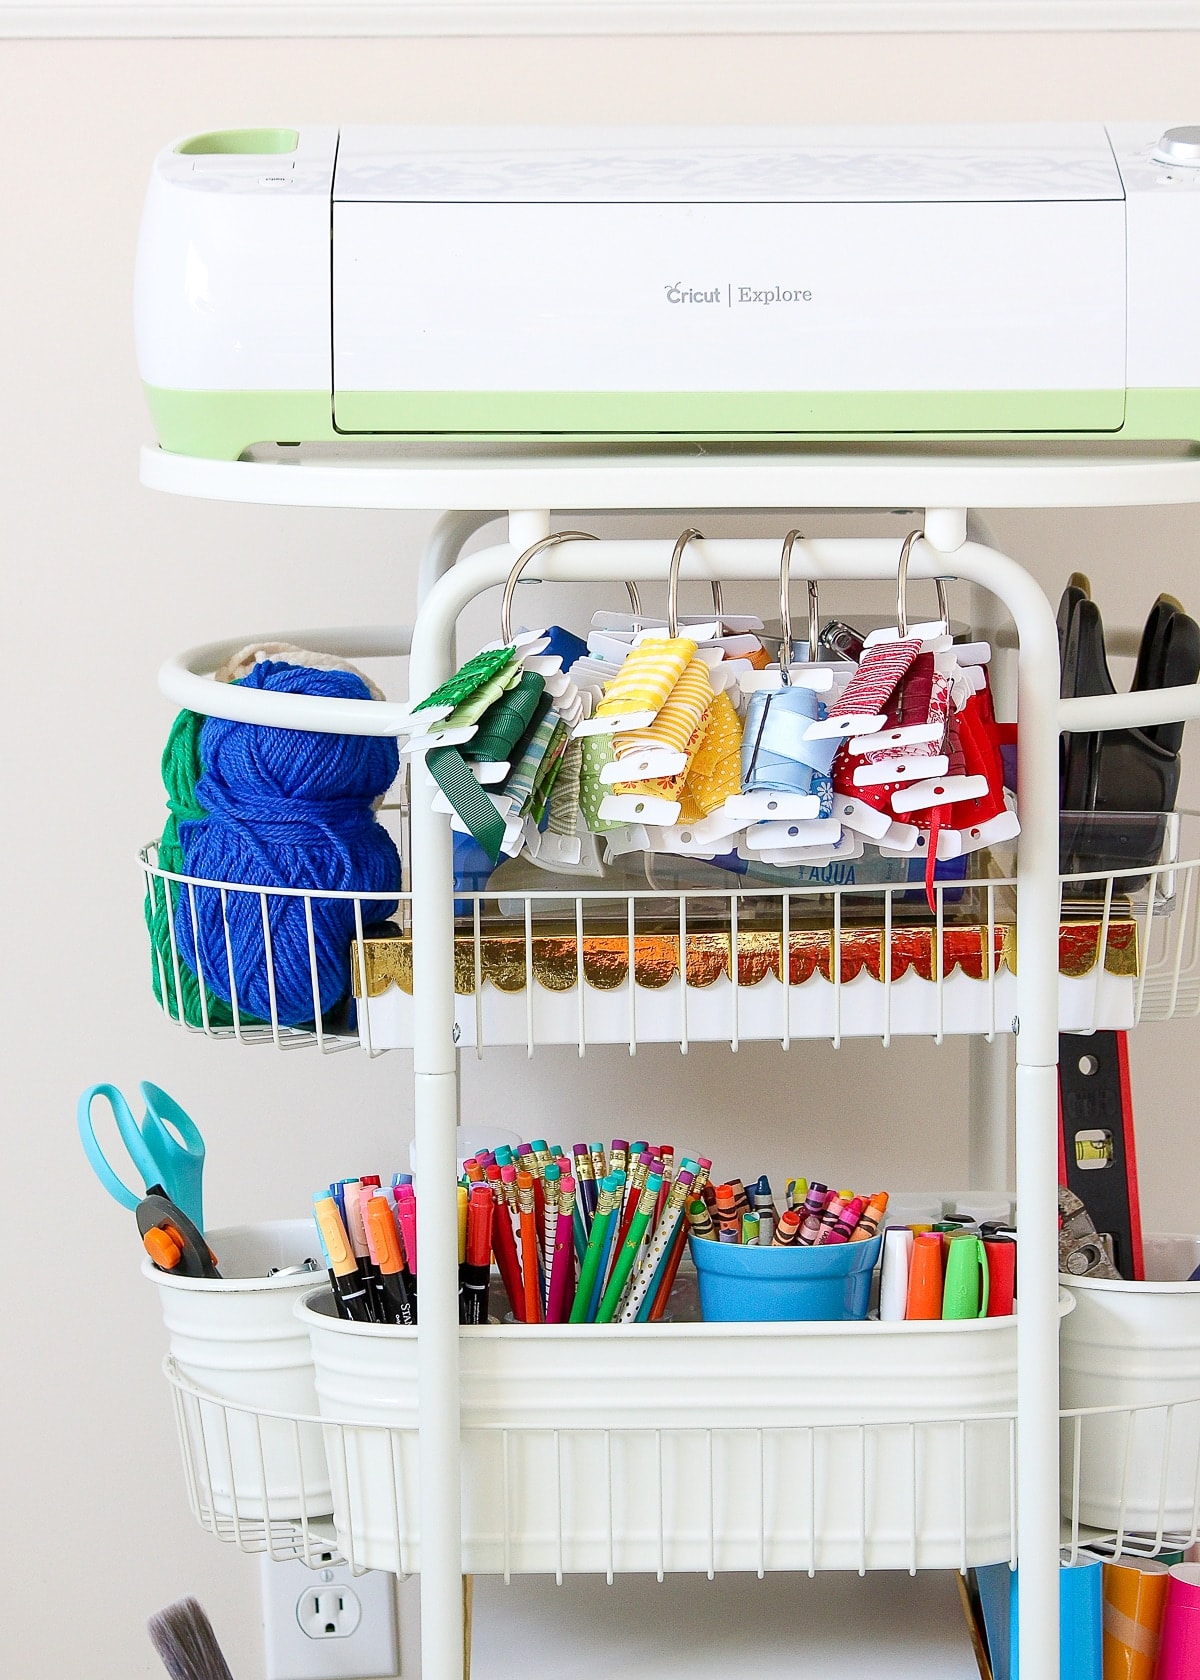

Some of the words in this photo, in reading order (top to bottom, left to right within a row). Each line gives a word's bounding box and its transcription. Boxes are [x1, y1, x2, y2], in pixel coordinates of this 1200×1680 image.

[664, 281, 721, 304] Cricut
[738, 286, 813, 305] Explore
[809, 862, 856, 885] AQUA
